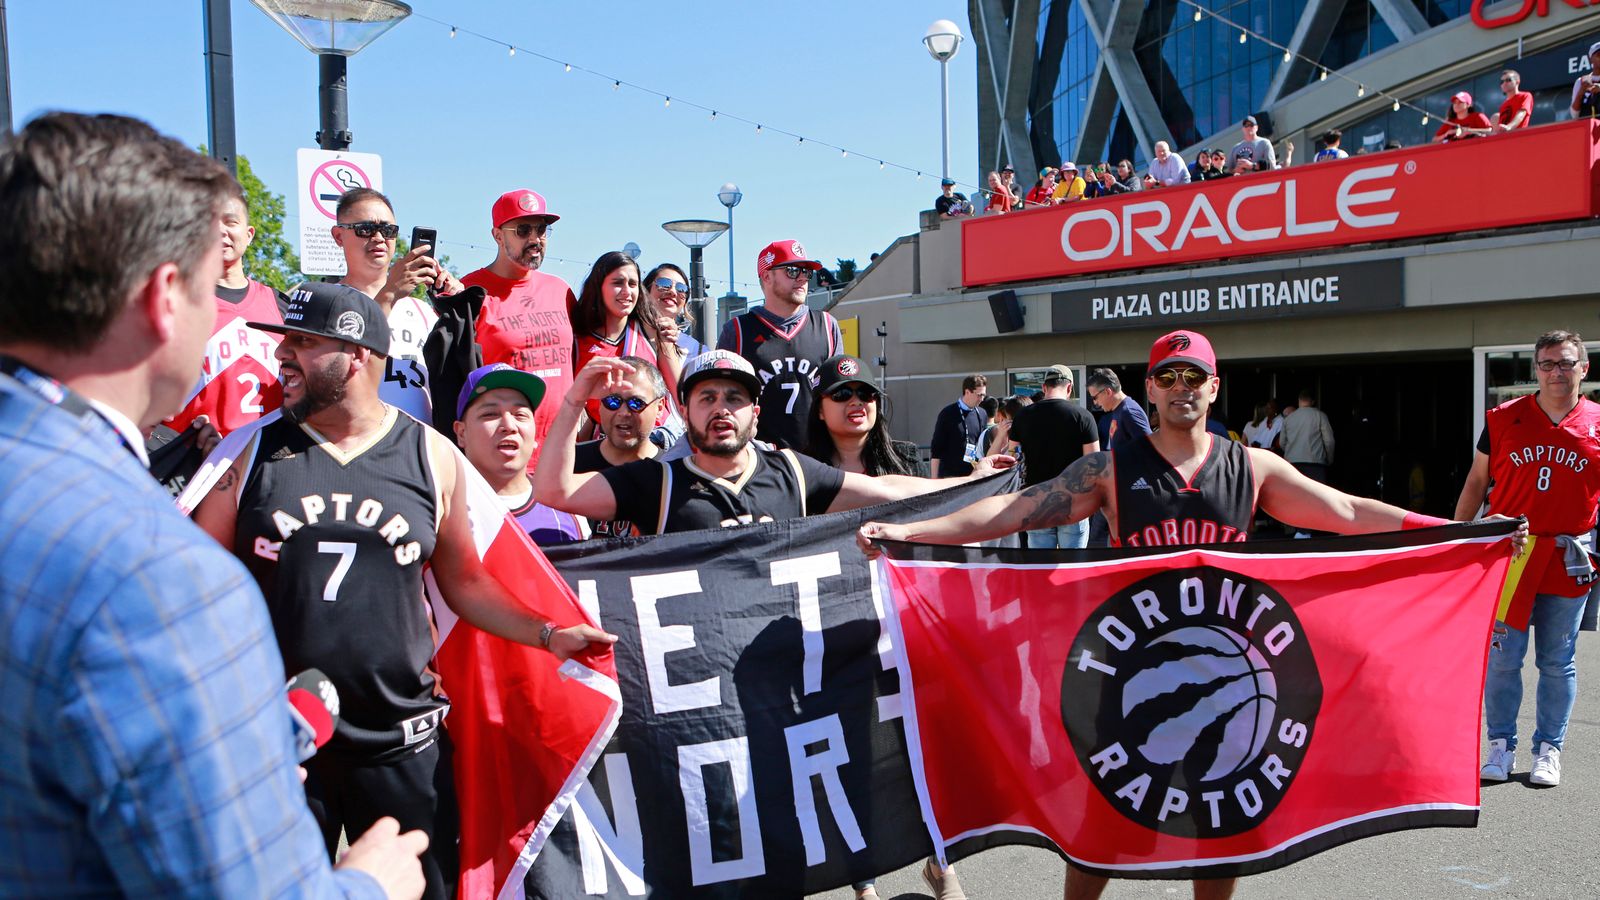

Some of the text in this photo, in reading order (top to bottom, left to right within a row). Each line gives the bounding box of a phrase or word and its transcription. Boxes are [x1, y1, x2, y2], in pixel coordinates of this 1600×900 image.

[1568, 55, 1594, 74] EA
[1060, 164, 1399, 262] ORACLE
[1092, 276, 1339, 320] PLAZA CLUB ENTRANCE
[500, 310, 568, 331] THE NORTH
[525, 328, 560, 348] OWNS
[511, 349, 540, 369] THE
[544, 347, 571, 365] EAST
[237, 372, 264, 413] 2
[781, 382, 800, 414] 7
[1510, 445, 1588, 473] RAPTORS
[1536, 466, 1551, 491] 8
[254, 493, 421, 566] RAPTORS
[318, 541, 357, 601] 7
[1077, 576, 1295, 677] TORONTO
[1089, 718, 1308, 829] RAPTORS
[571, 694, 904, 896] NOR
